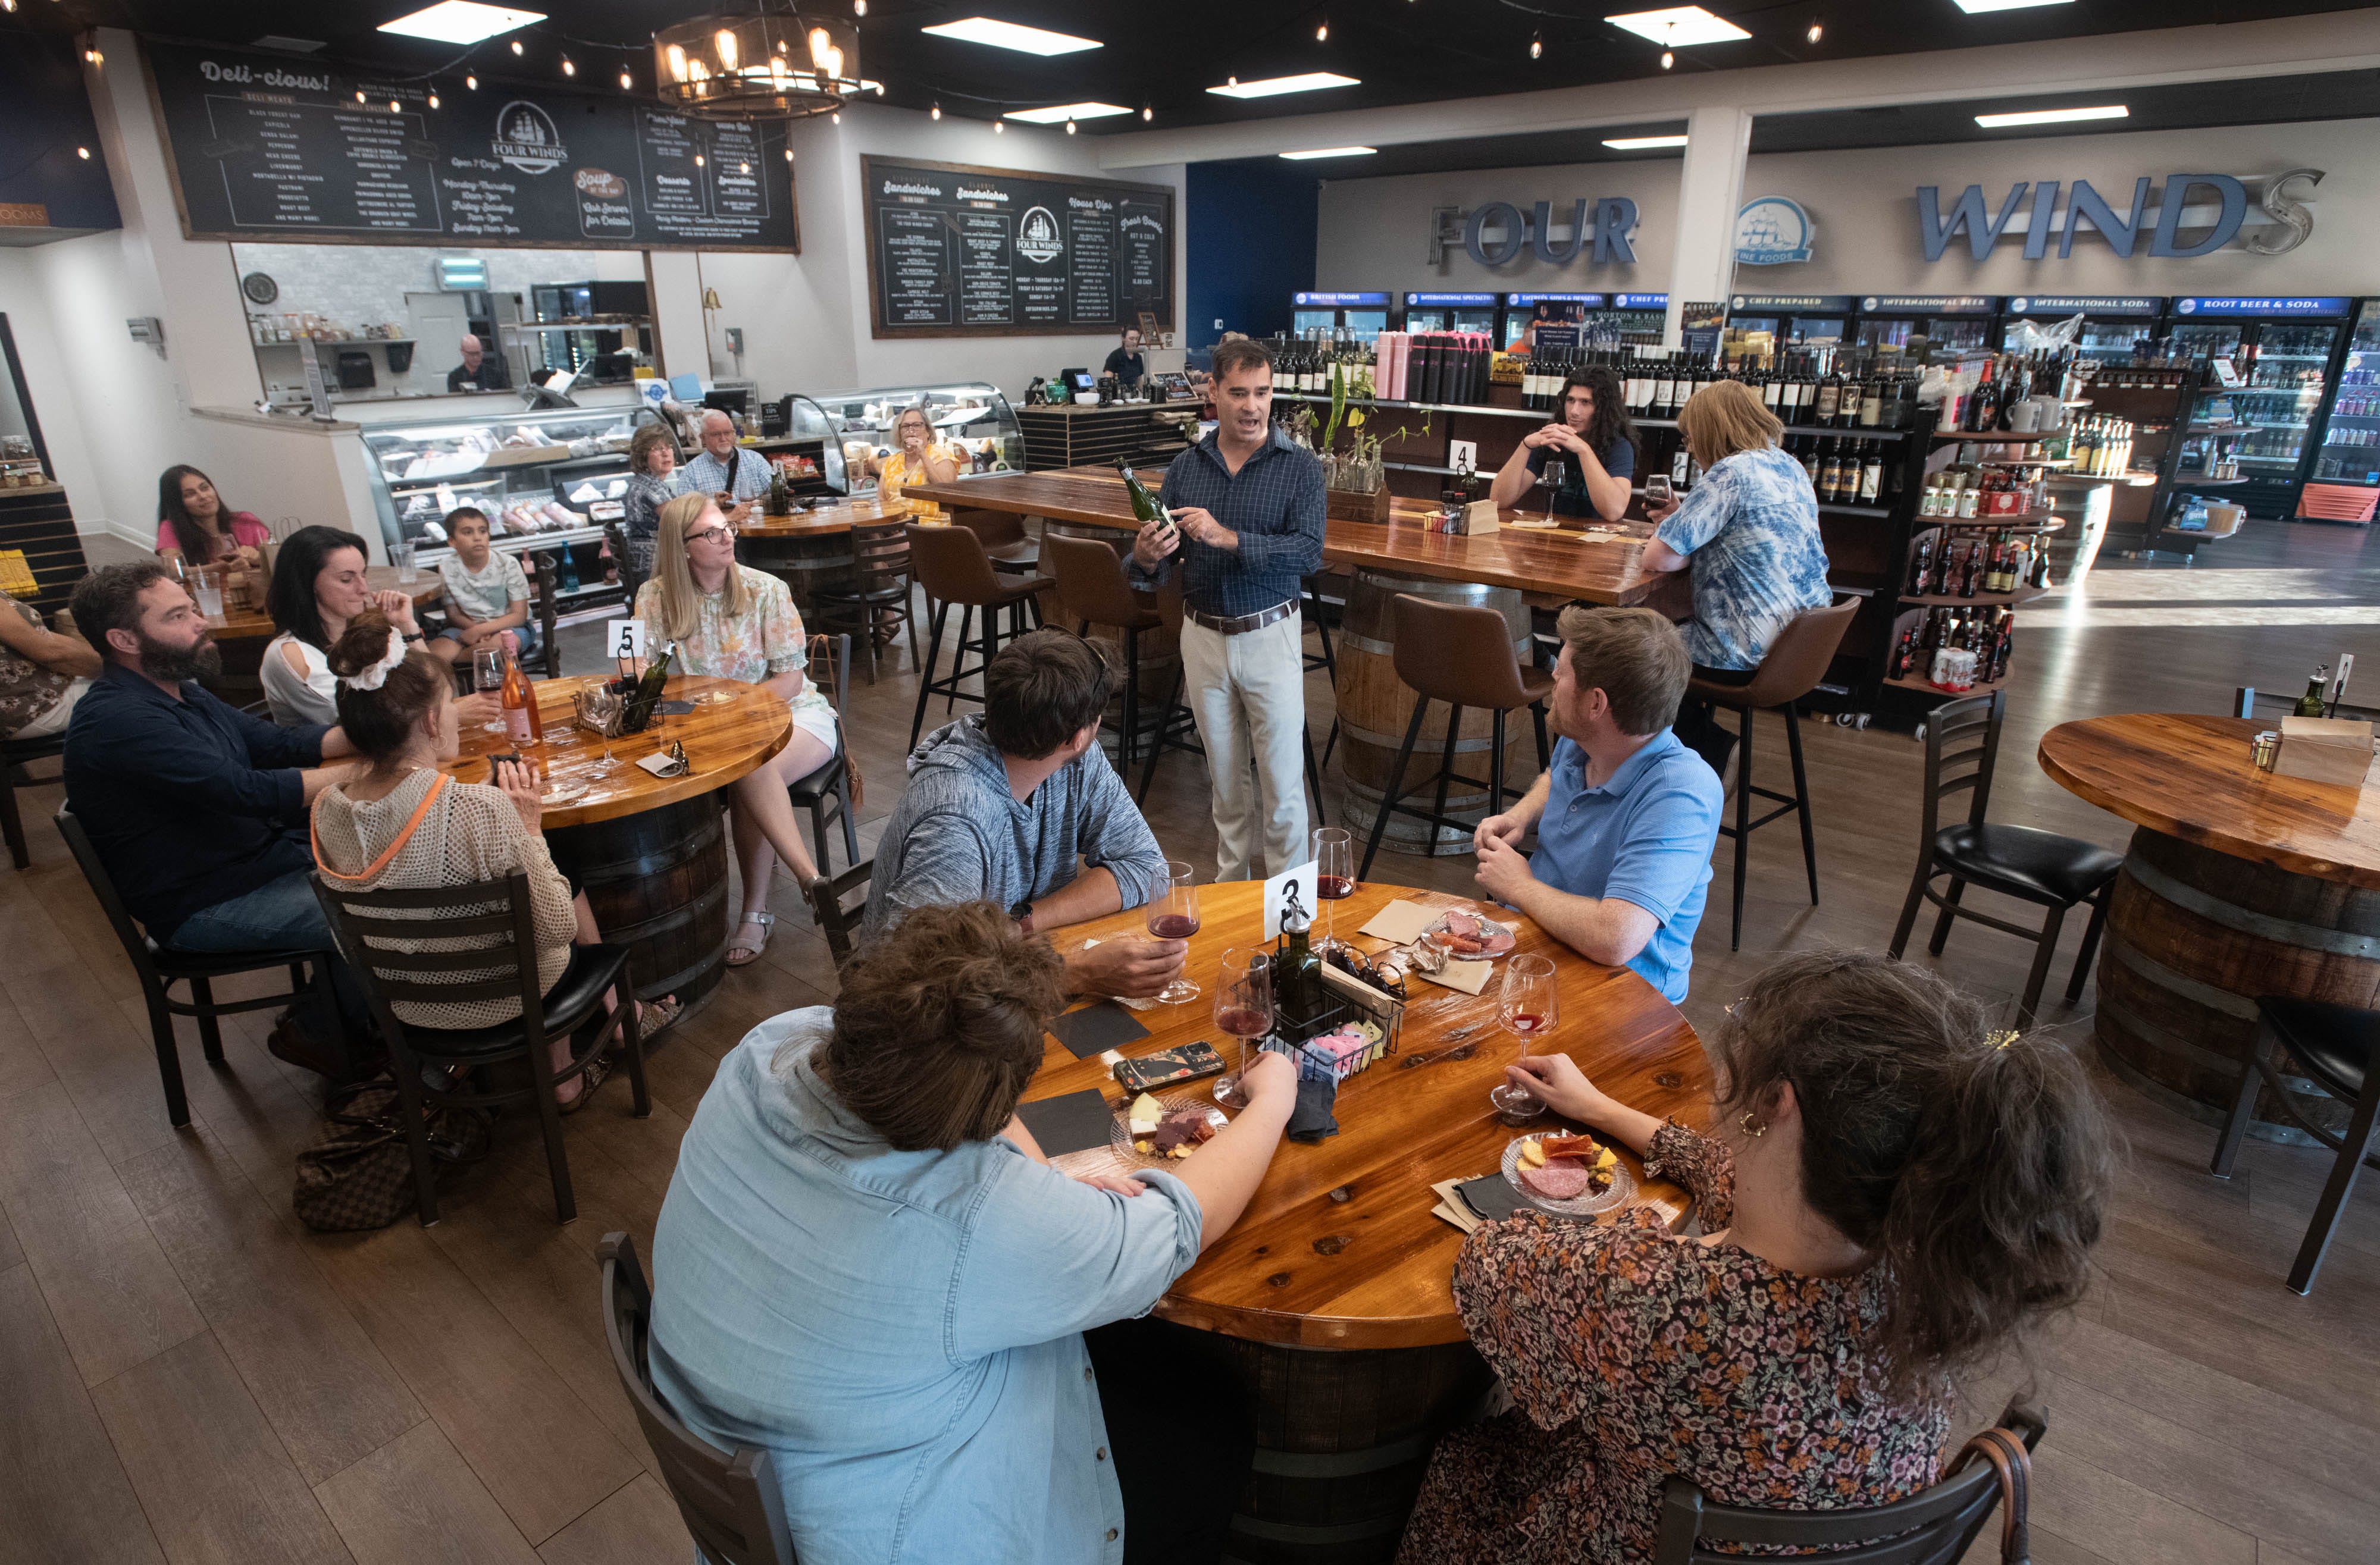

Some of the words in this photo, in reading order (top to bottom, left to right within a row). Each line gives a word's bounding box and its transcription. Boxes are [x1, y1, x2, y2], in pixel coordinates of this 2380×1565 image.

[200, 61, 330, 91] Deli-cious!
[493, 144, 528, 156] FOUR
[528, 147, 568, 159] WINDS
[577, 171, 613, 189] Soup
[884, 180, 941, 196] Sandwiches
[956, 187, 1009, 202] Sandwiches
[1069, 197, 1094, 208] House
[1095, 199, 1113, 211] Dips
[1121, 216, 1141, 231] Fresh
[1142, 215, 1163, 233] Bowls
[1427, 196, 1640, 266] FOUR
[1915, 167, 2326, 262] WINDS
[1016, 240, 1038, 249] FOUR
[1038, 242, 1063, 250] WINDS
[1759, 252, 1793, 262] FOODS
[2034, 299, 2119, 308] INTERNATIONAL
[1596, 311, 1633, 320] MORTON
[1458, 446, 1467, 463] 4
[621, 626, 633, 651] 5
